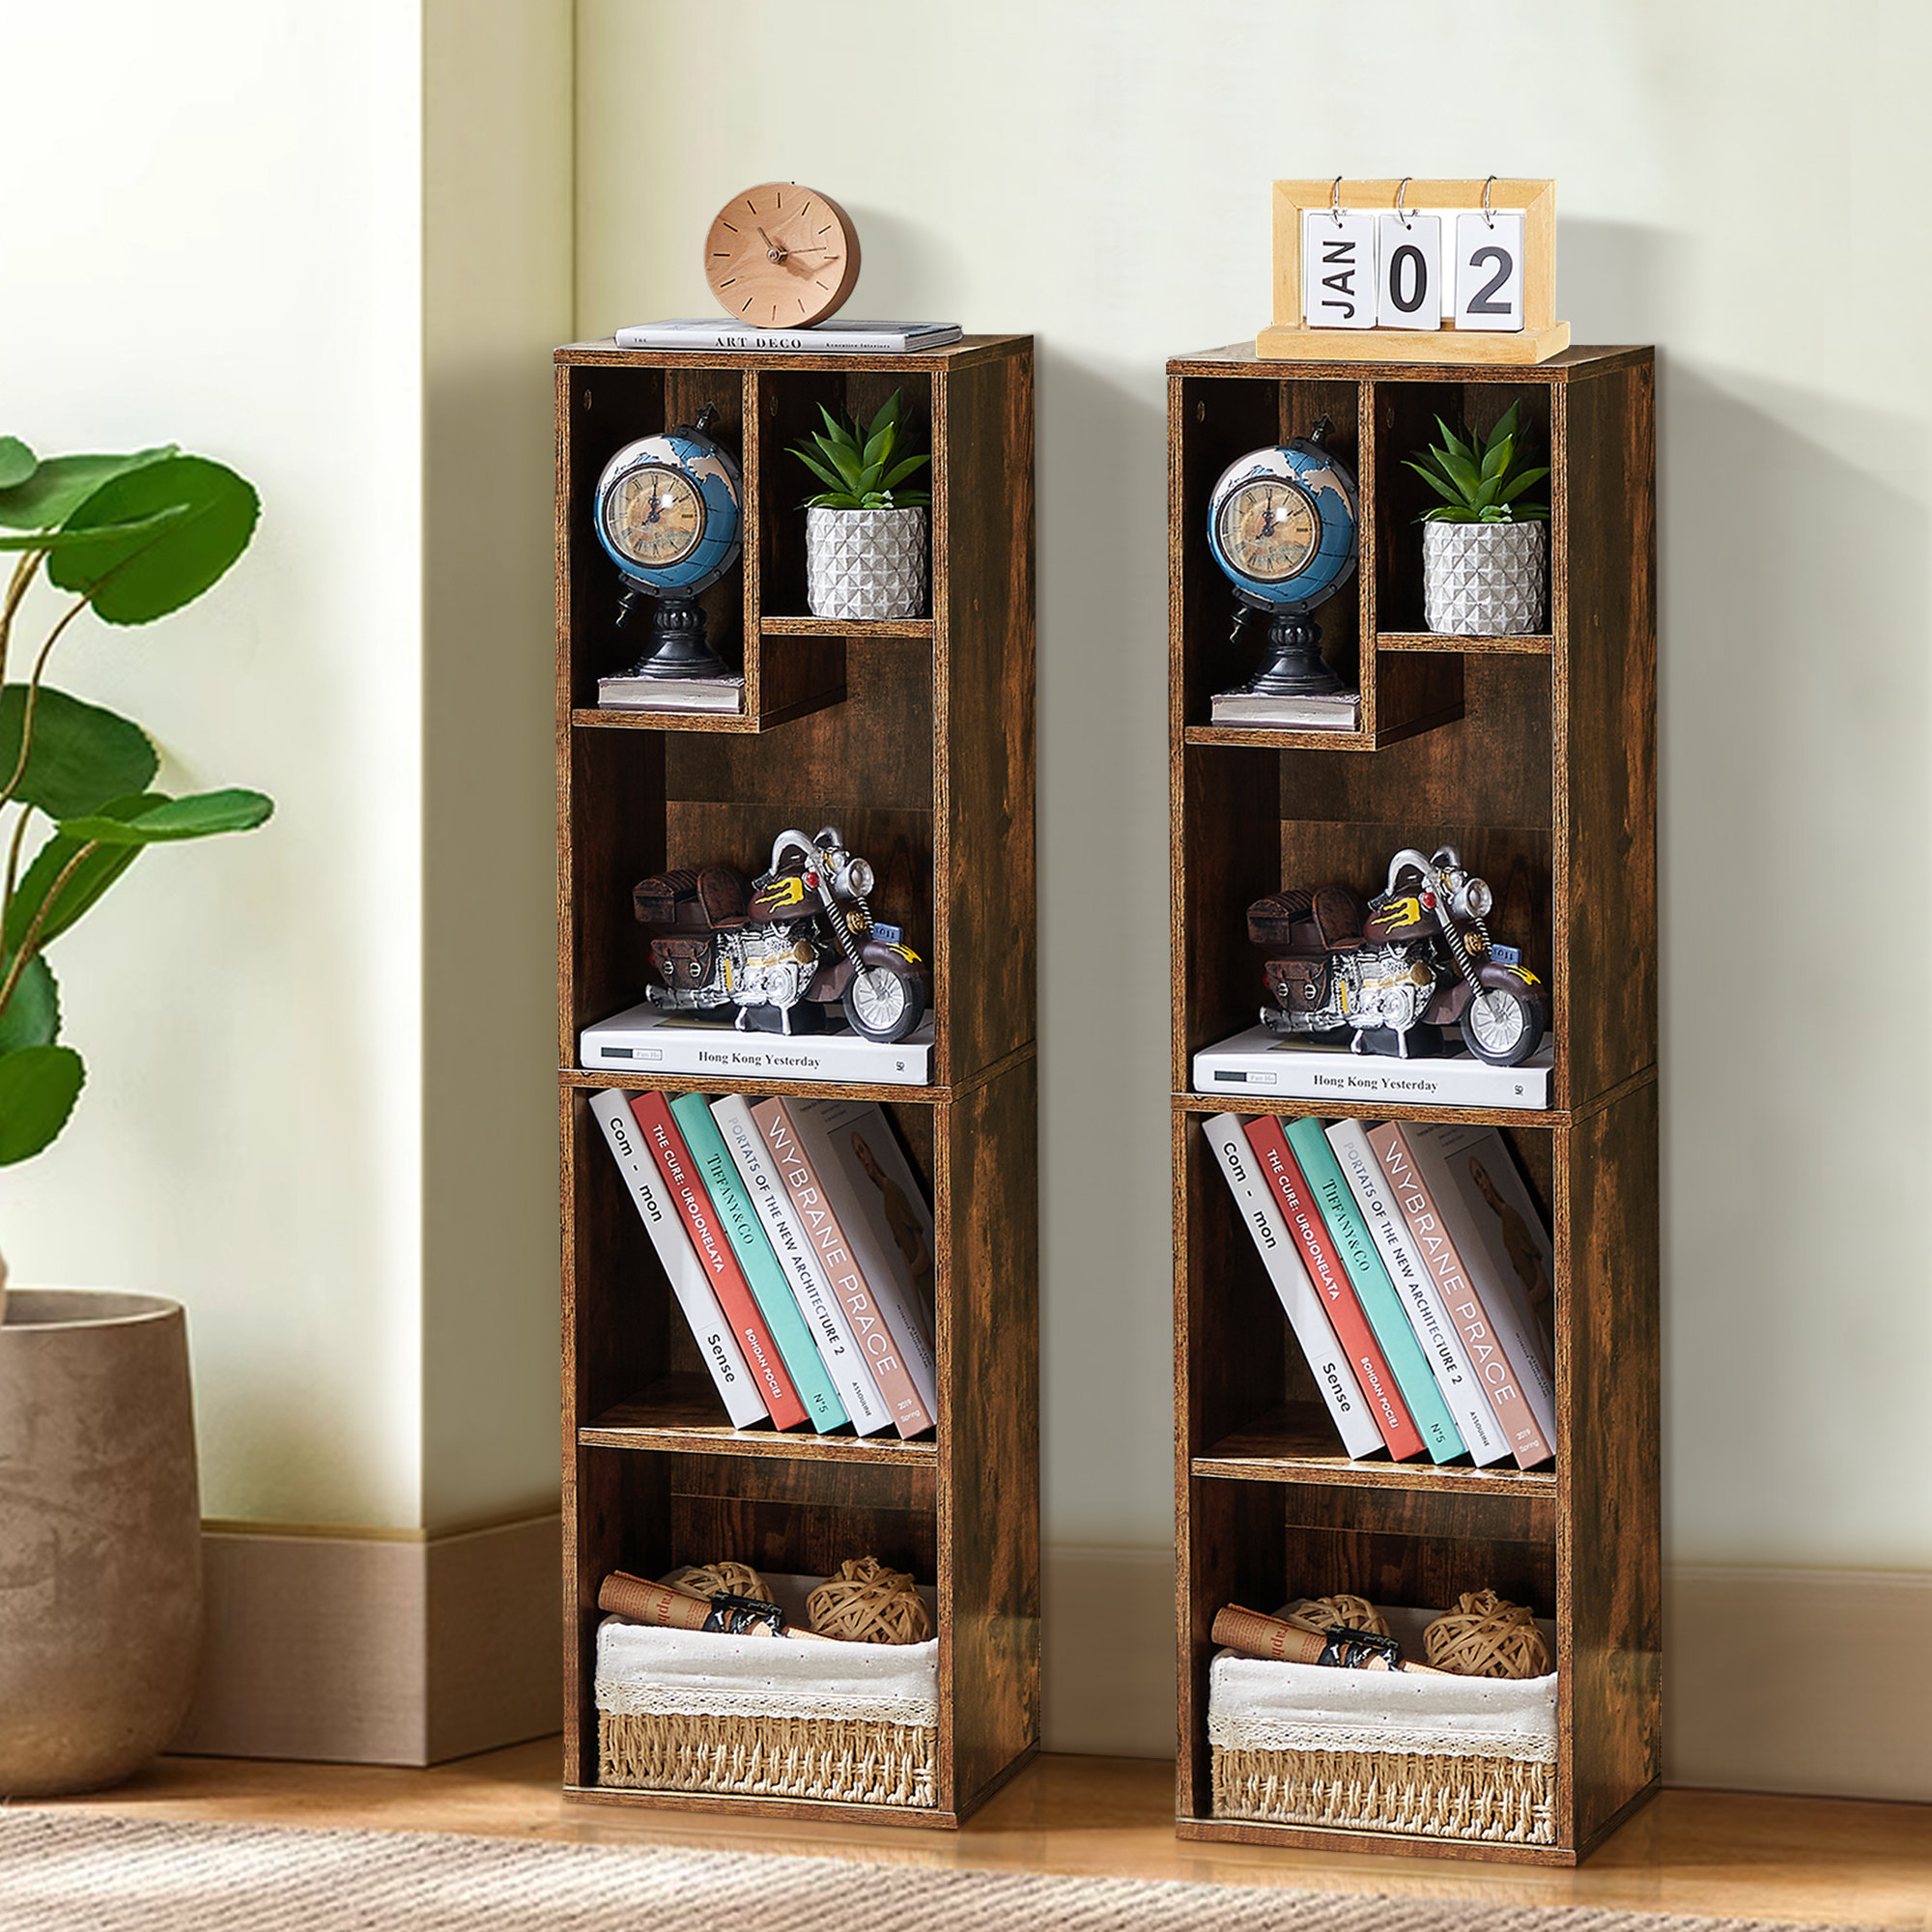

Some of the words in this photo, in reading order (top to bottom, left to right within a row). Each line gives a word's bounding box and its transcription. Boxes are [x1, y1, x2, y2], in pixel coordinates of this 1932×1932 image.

[715, 337, 748, 348] ART
[756, 338, 802, 349] DECO
[1321, 241, 1356, 319] JAN
[698, 1051, 728, 1064] Hong
[732, 1053, 761, 1066] Kong
[766, 1054, 821, 1069] Yesterday
[1314, 1074, 1345, 1088] Hong
[1348, 1076, 1378, 1090] Kong
[1381, 1078, 1438, 1094] Yesterday
[610, 1117, 634, 1157] Com
[639, 1184, 663, 1222] mon
[708, 1333, 735, 1383] Sense
[653, 1124, 671, 1150] THE
[665, 1149, 685, 1186] CURE:
[681, 1187, 724, 1273] UROJONELATA
[745, 1328, 767, 1370] BOHDAN
[728, 1117, 759, 1173] PORTATS
[756, 1175, 772, 1193] OF
[765, 1194, 782, 1220] THE
[777, 1221, 797, 1252] NEW
[792, 1256, 839, 1346] ARCHITECTURE
[835, 1346, 845, 1356] 2
[769, 1116, 847, 1267] WYBRANE
[838, 1274, 897, 1376] PRACE
[1223, 1142, 1246, 1182] Com
[1253, 1210, 1277, 1250] mon
[1322, 1362, 1351, 1412] Sense
[1266, 1149, 1285, 1175] THE
[1278, 1174, 1299, 1212] CURE:
[1296, 1213, 1340, 1300] UROJONELATA
[1360, 1356, 1384, 1401] BOHDAN
[1344, 1142, 1375, 1200] PORTATS
[1372, 1201, 1386, 1220] OF
[1380, 1220, 1398, 1247] THE
[1393, 1248, 1413, 1279] NEW
[1408, 1283, 1457, 1376] ARCHITECTURE
[1451, 1375, 1463, 1385] 2
[1385, 1140, 1464, 1295] WYBRANE
[1456, 1302, 1517, 1405] PRACE
